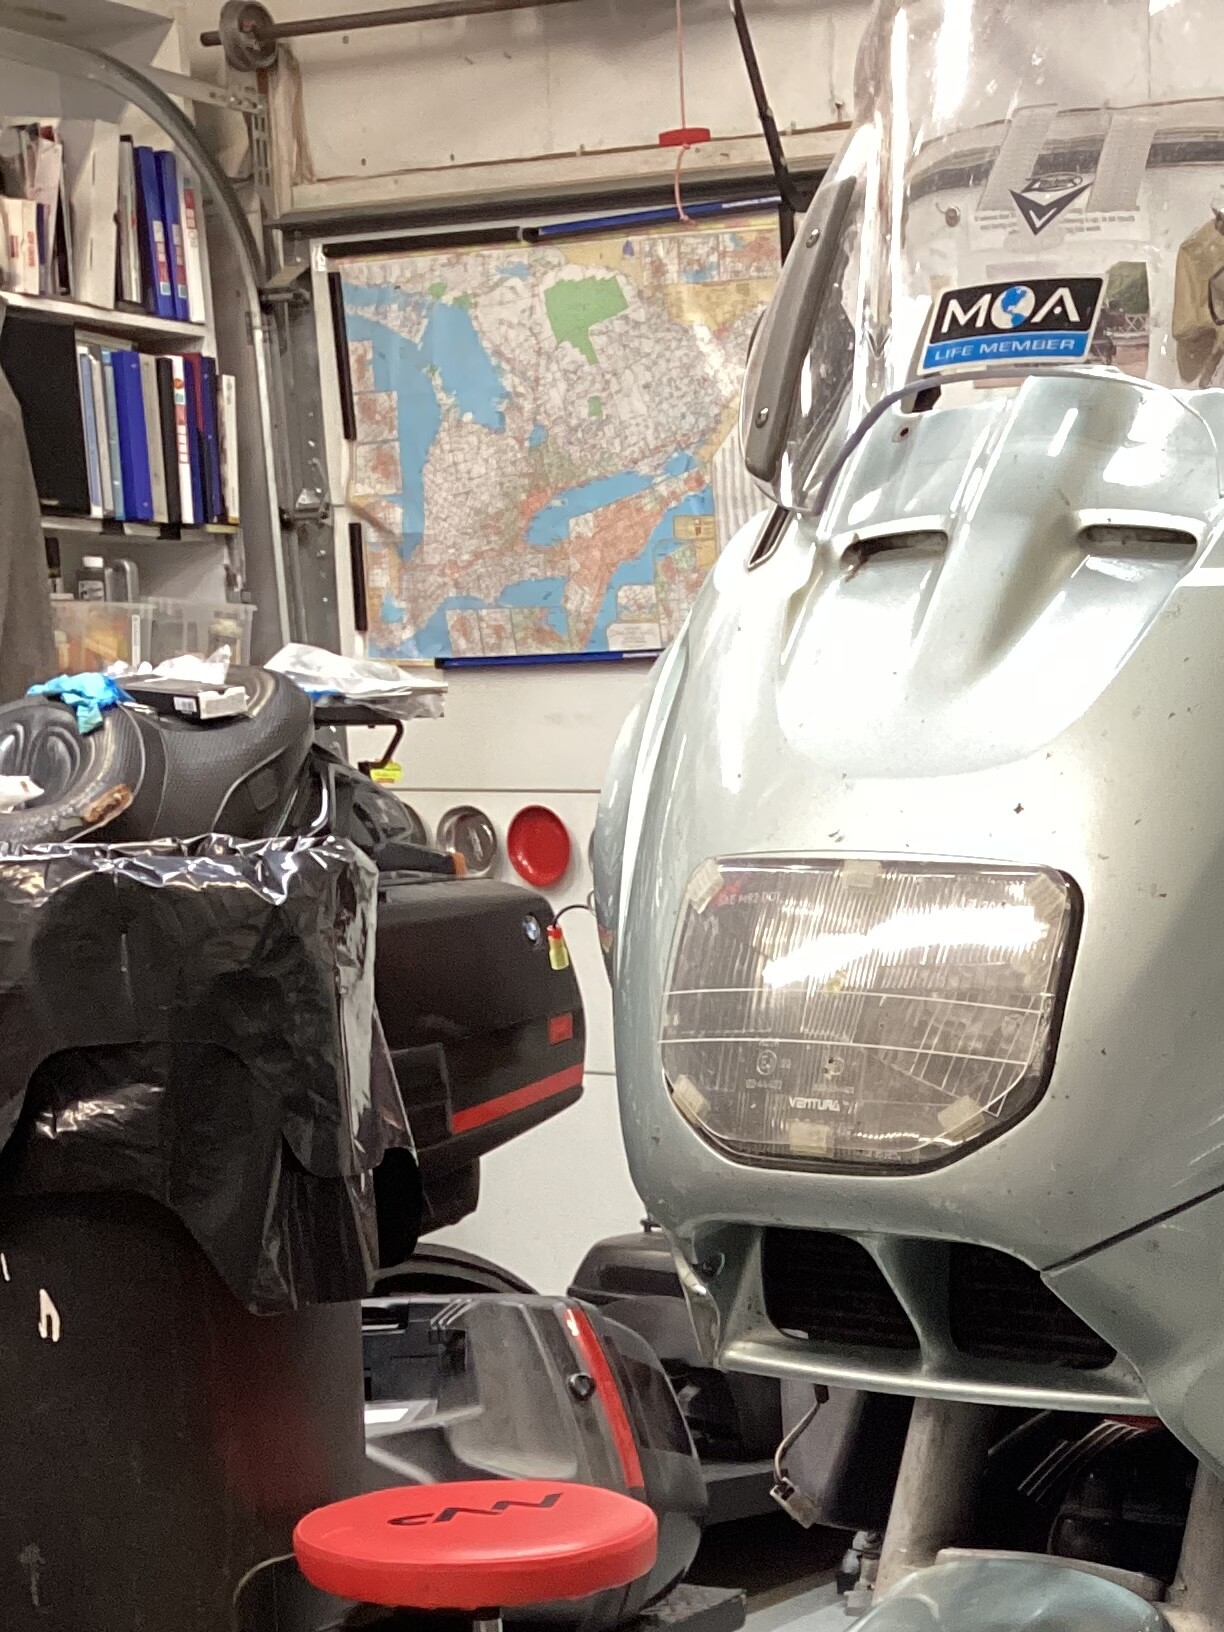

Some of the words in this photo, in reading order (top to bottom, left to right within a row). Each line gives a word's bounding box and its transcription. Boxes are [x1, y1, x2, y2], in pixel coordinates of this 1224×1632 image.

[941, 285, 1081, 334] MOA
[934, 344, 975, 361] LIFE
[979, 338, 1076, 355] MEMBER
